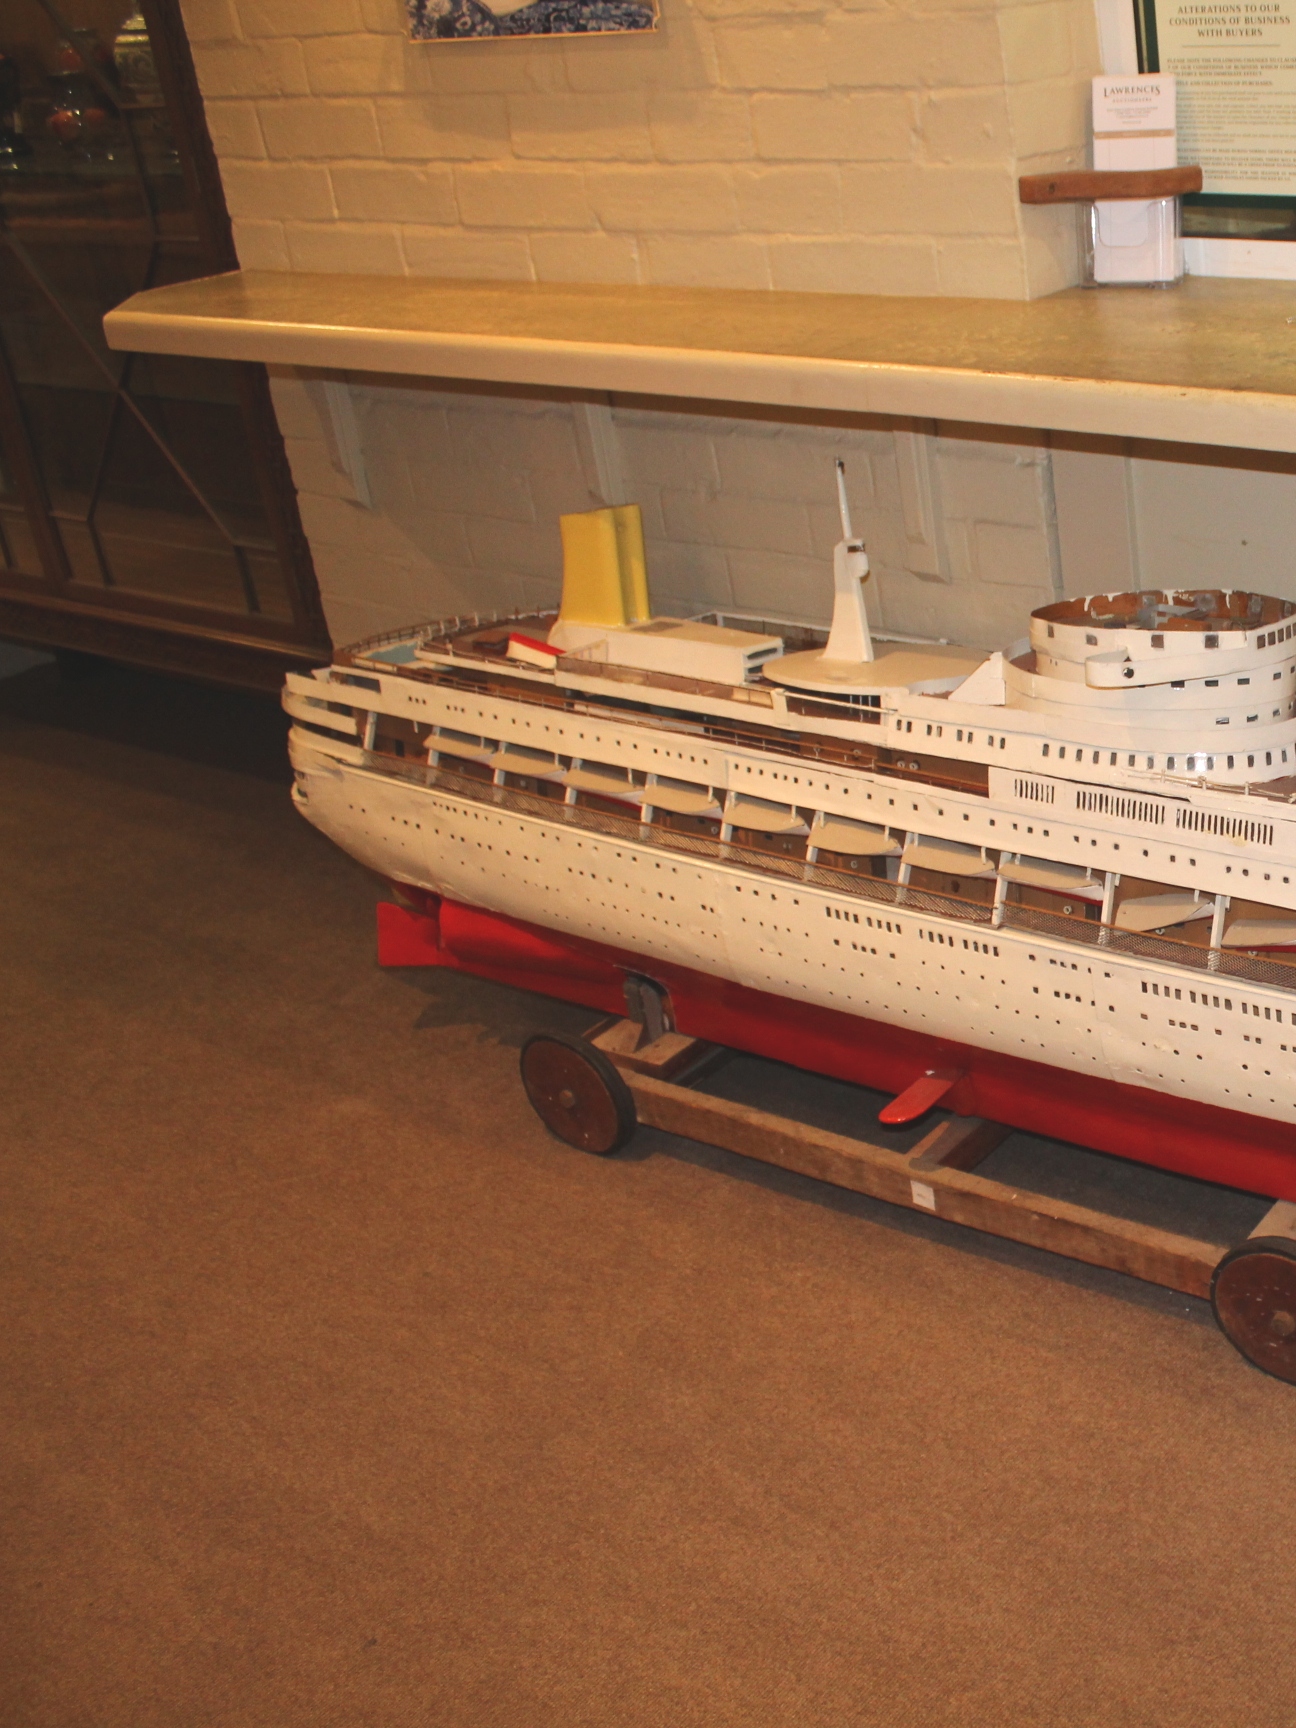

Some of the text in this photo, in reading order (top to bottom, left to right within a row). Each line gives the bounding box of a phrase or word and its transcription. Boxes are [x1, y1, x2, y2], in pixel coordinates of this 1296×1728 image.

[1178, 4, 1280, 14] ALTERATIONS TO OUR
[1170, 16, 1290, 26] CONDITIONS OF BUSINESS
[1197, 28, 1263, 38] WITH BUYERS
[1104, 85, 1160, 98] LAWRENCES
